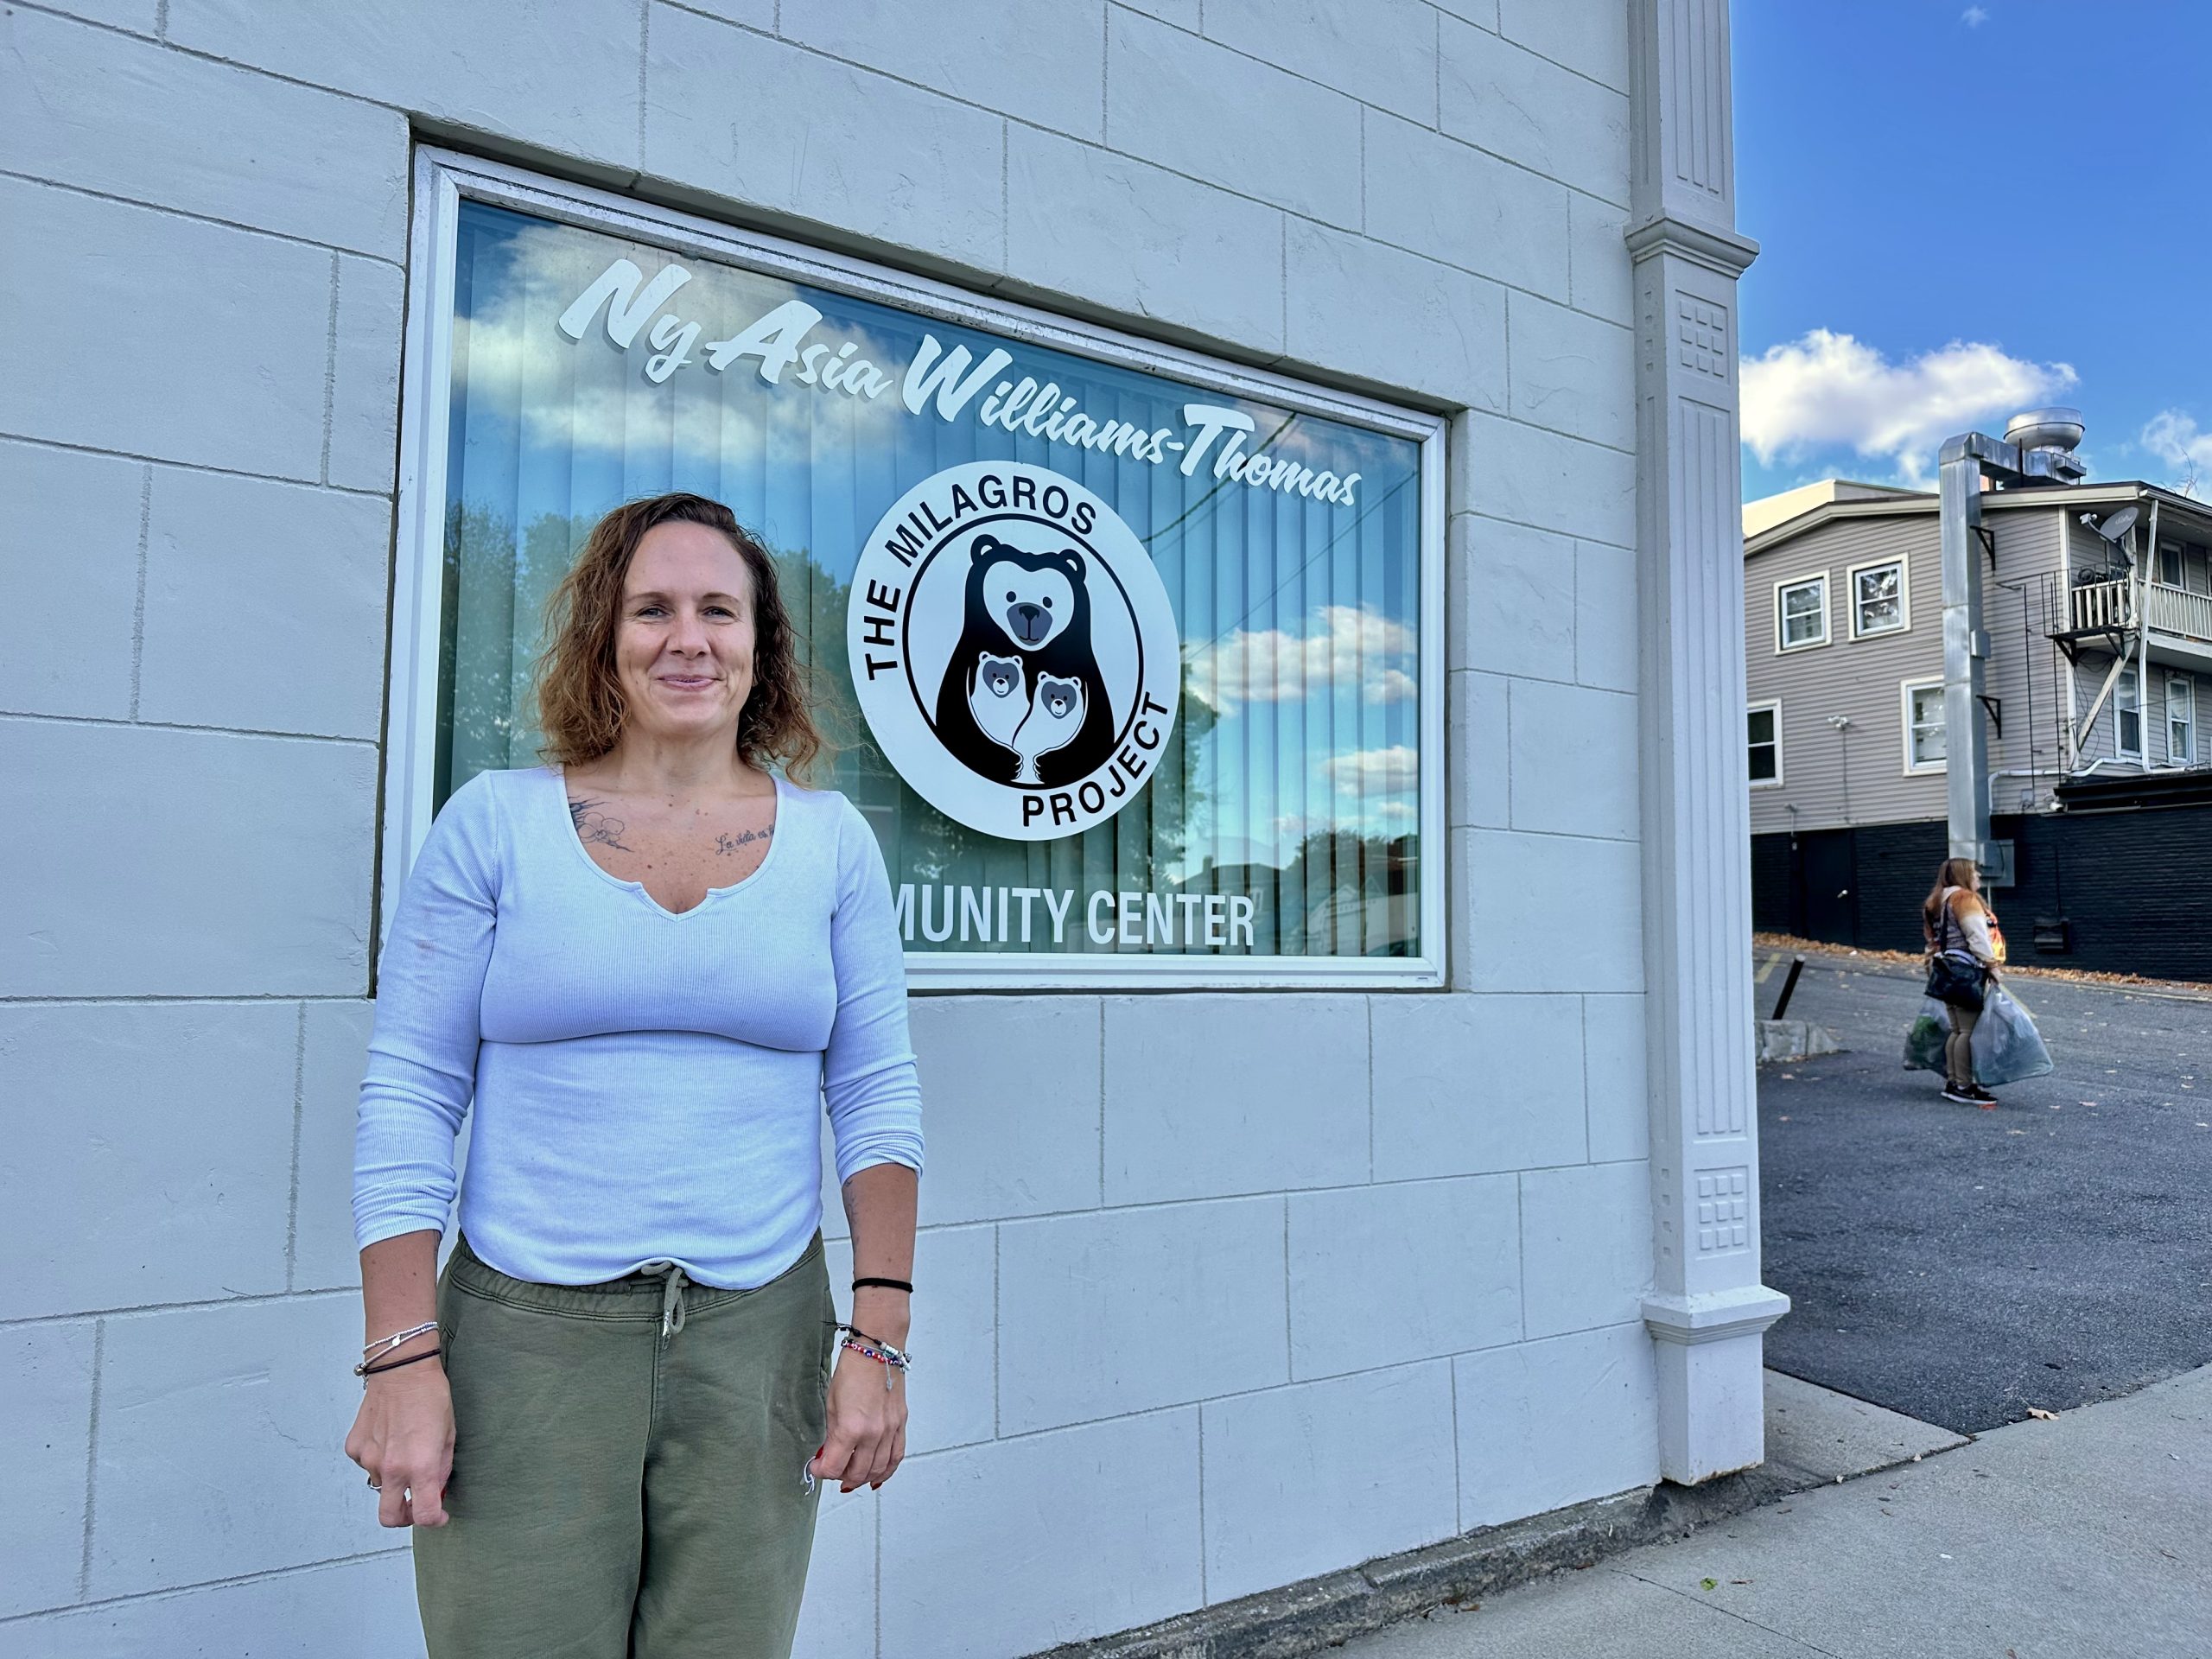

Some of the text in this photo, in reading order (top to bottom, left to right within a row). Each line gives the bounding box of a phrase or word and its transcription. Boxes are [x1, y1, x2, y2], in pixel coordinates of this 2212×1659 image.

[901, 334, 1362, 506] Williams-Thomas
[864, 474, 1096, 681] THE MILAGROS
[1022, 691, 1169, 827] PROJECT
[1087, 890, 1255, 947] CENTER
